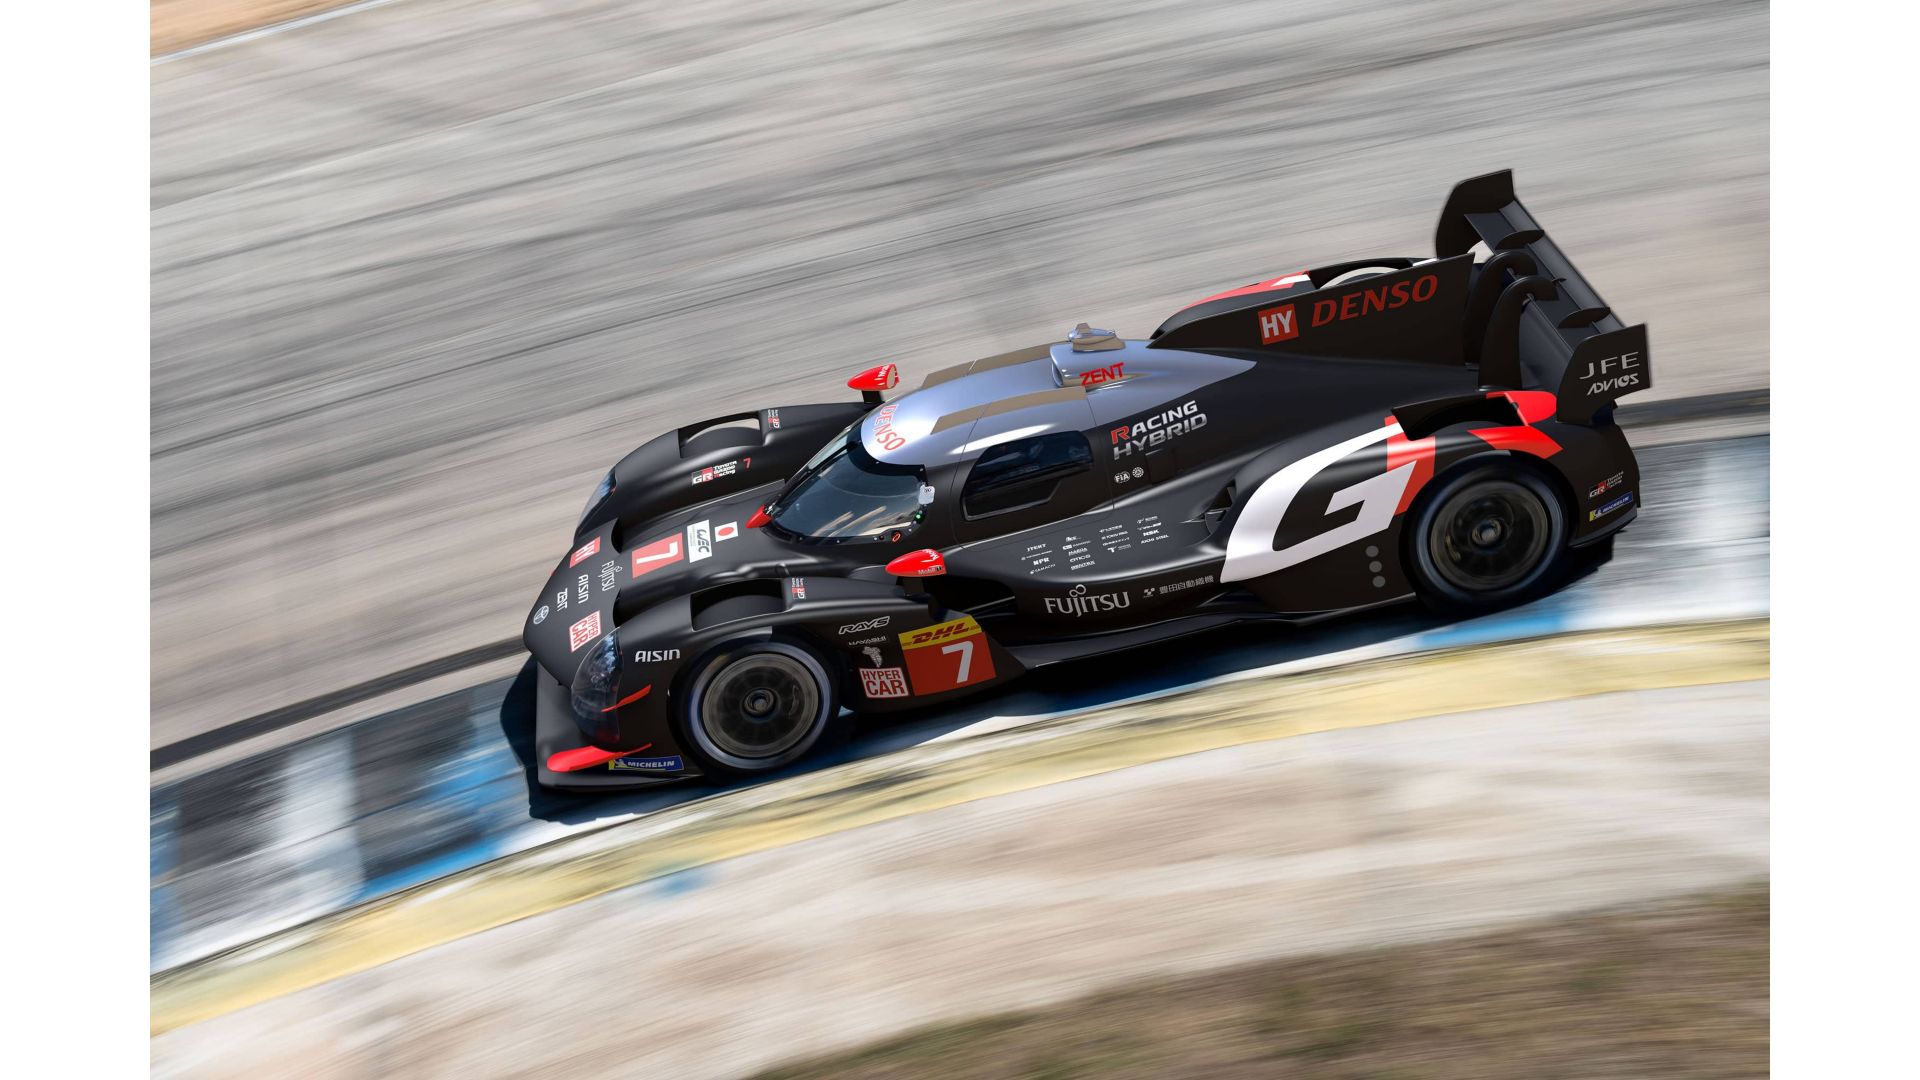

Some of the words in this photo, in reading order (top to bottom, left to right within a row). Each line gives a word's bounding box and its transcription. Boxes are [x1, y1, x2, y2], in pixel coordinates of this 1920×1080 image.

[1261, 310, 1292, 338] HY
[1312, 275, 1438, 327] DENSO
[1080, 362, 1124, 386] ZENT
[1579, 352, 1640, 379] JFE
[1587, 373, 1639, 395] ADVICS
[875, 405, 905, 450] DENSO
[1111, 400, 1197, 444] RACING
[1113, 413, 1207, 460] HYBRID
[743, 458, 751, 468] 7
[692, 472, 713, 484] GR
[1114, 474, 1130, 483] FIA
[575, 540, 595, 562] HY
[696, 528, 710, 553] WEC
[636, 541, 679, 565] 7
[598, 560, 623, 592] FUJITSU
[578, 574, 589, 604] AISIN
[1044, 584, 1130, 617] FUJITSU
[572, 620, 589, 649] CAR
[588, 614, 599, 639] HYPER
[838, 616, 890, 634] RAYS
[911, 622, 969, 645] DHL
[635, 649, 681, 662] AISIN
[942, 640, 974, 684] 7
[862, 669, 900, 680] HYPER
[865, 680, 904, 697] CAR
[627, 760, 675, 768] MICHELIN
